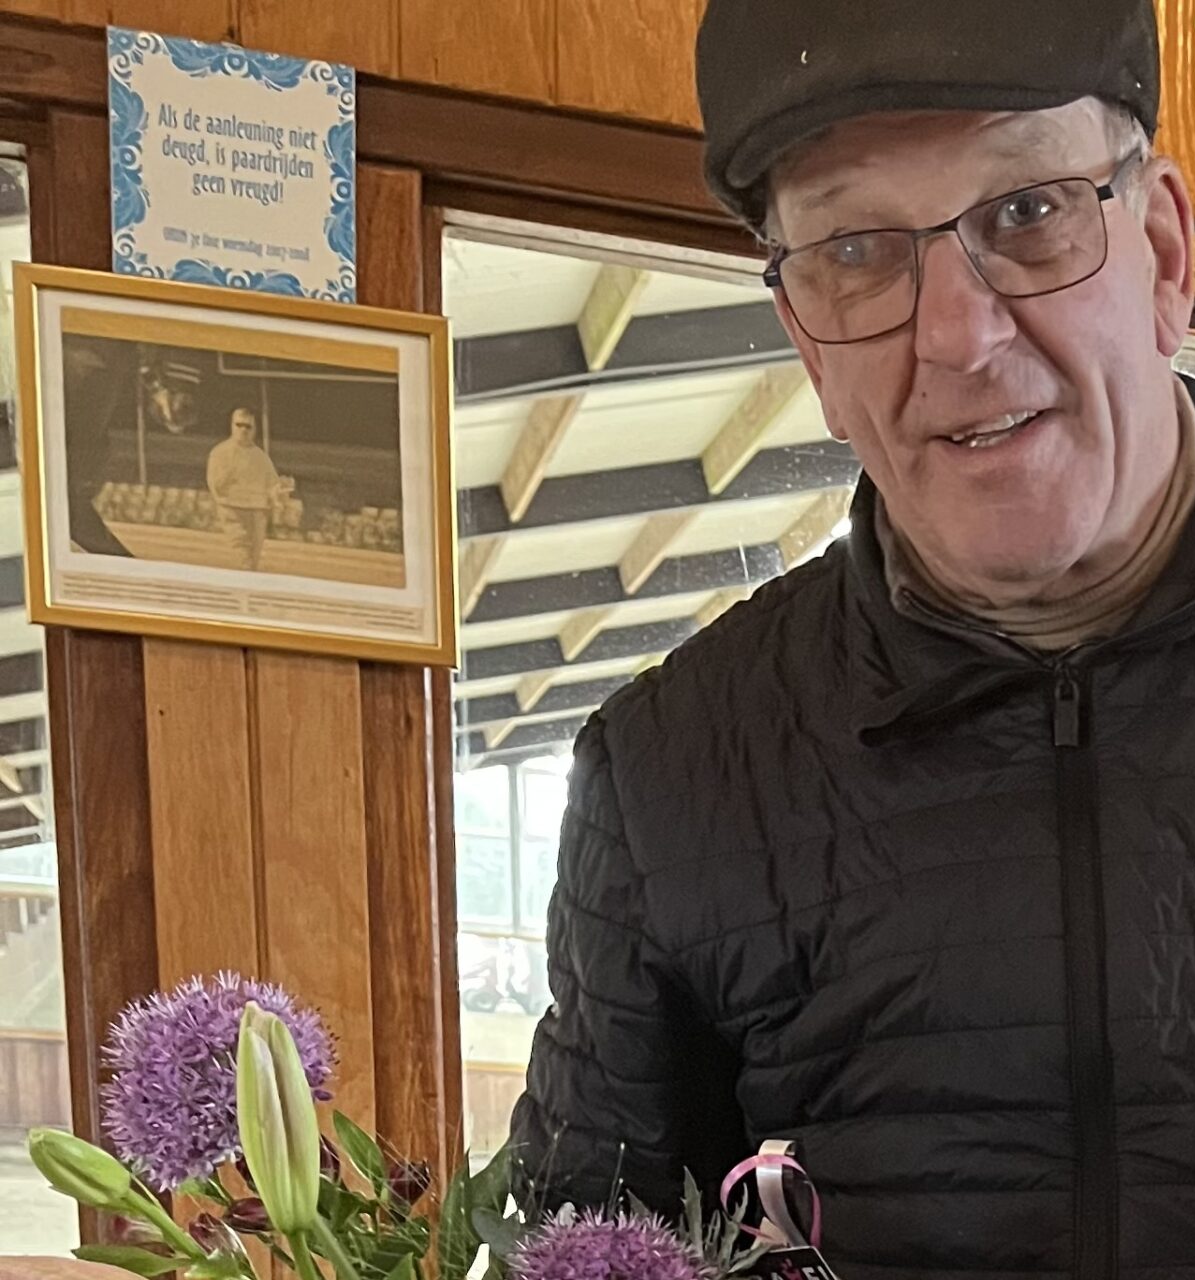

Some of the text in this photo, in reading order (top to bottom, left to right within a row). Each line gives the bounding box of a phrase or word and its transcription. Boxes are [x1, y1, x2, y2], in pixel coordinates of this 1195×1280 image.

[158, 103, 317, 151] Als de aanleuning niet
[162, 134, 314, 179] deugd, is paardrijden
[192, 172, 284, 206] geen vreugd!
